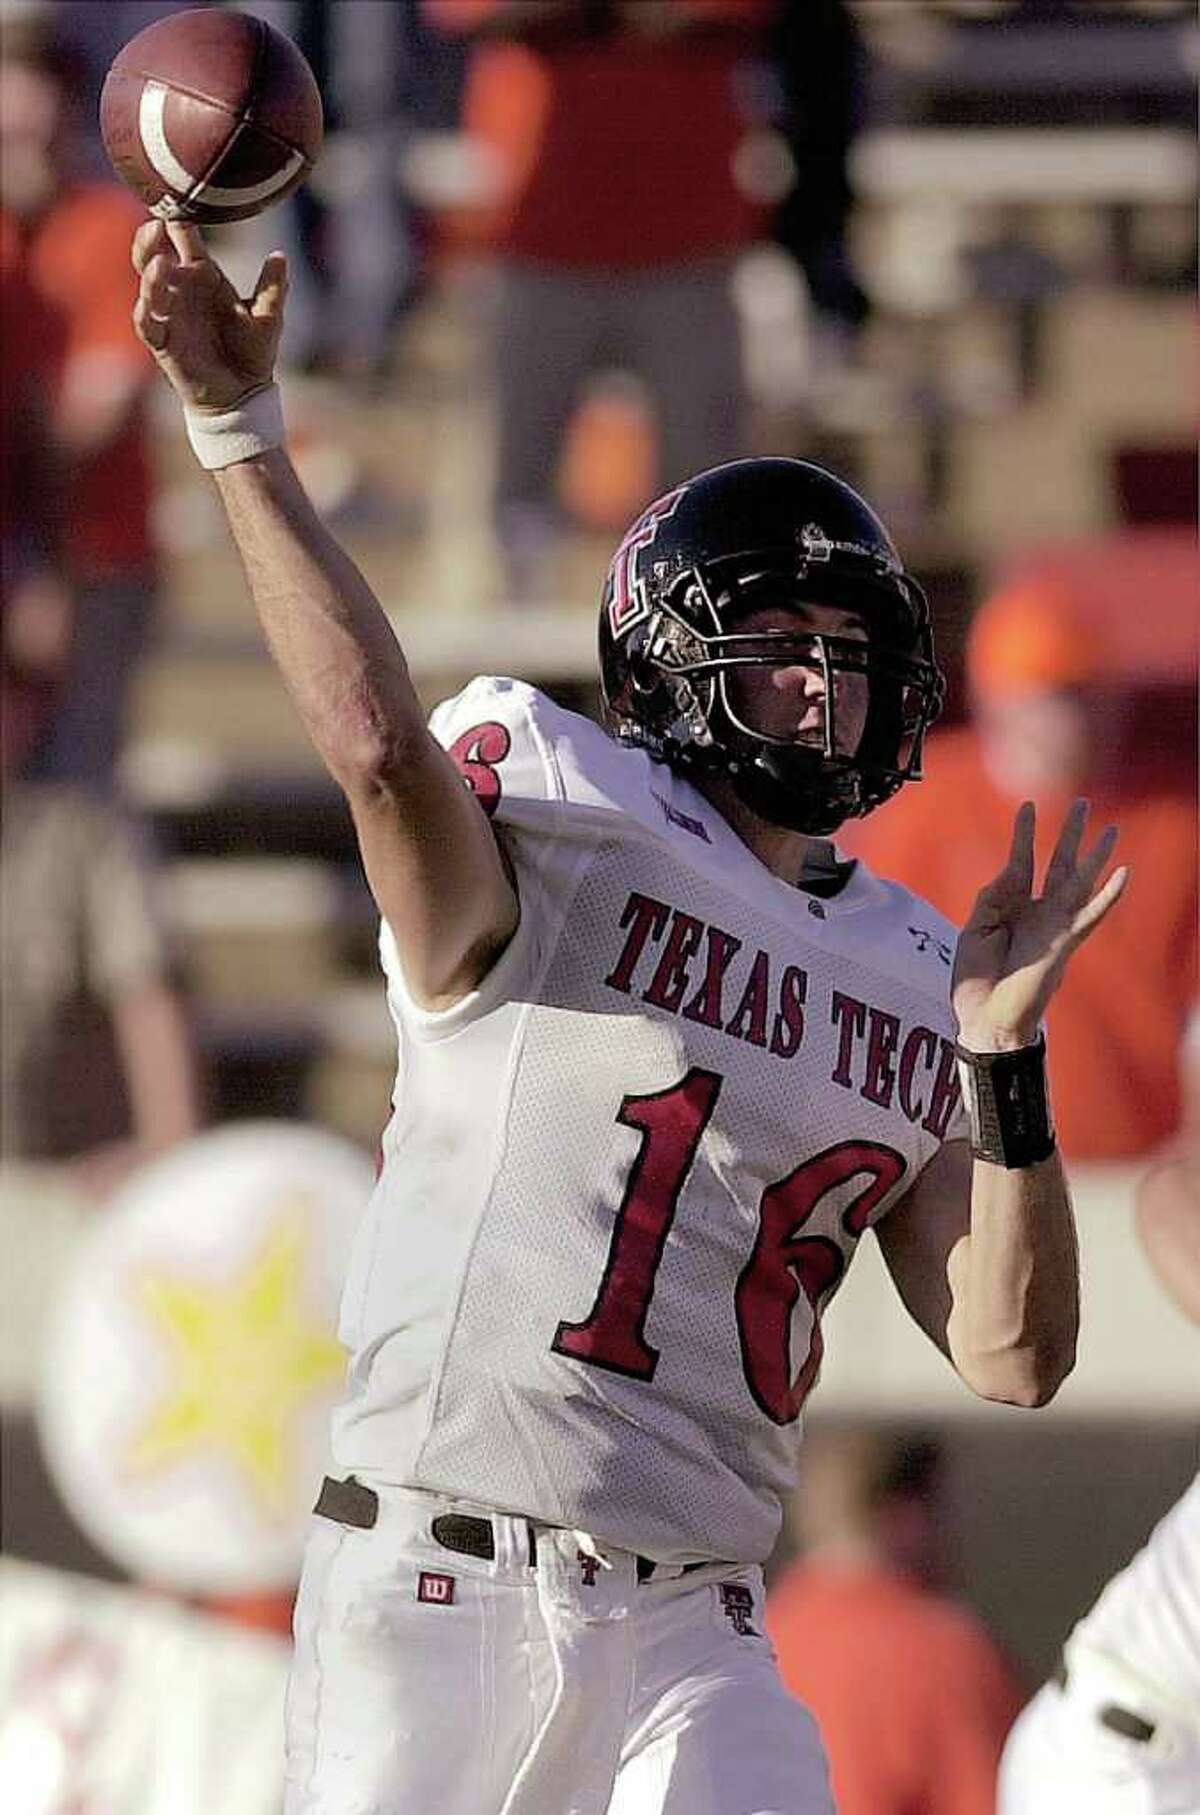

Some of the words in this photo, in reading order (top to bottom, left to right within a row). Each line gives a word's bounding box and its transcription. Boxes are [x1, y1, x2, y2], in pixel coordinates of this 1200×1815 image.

[605, 891, 808, 1059] TEXAS
[831, 990, 962, 1140] TECH
[550, 1065, 908, 1427] 16
